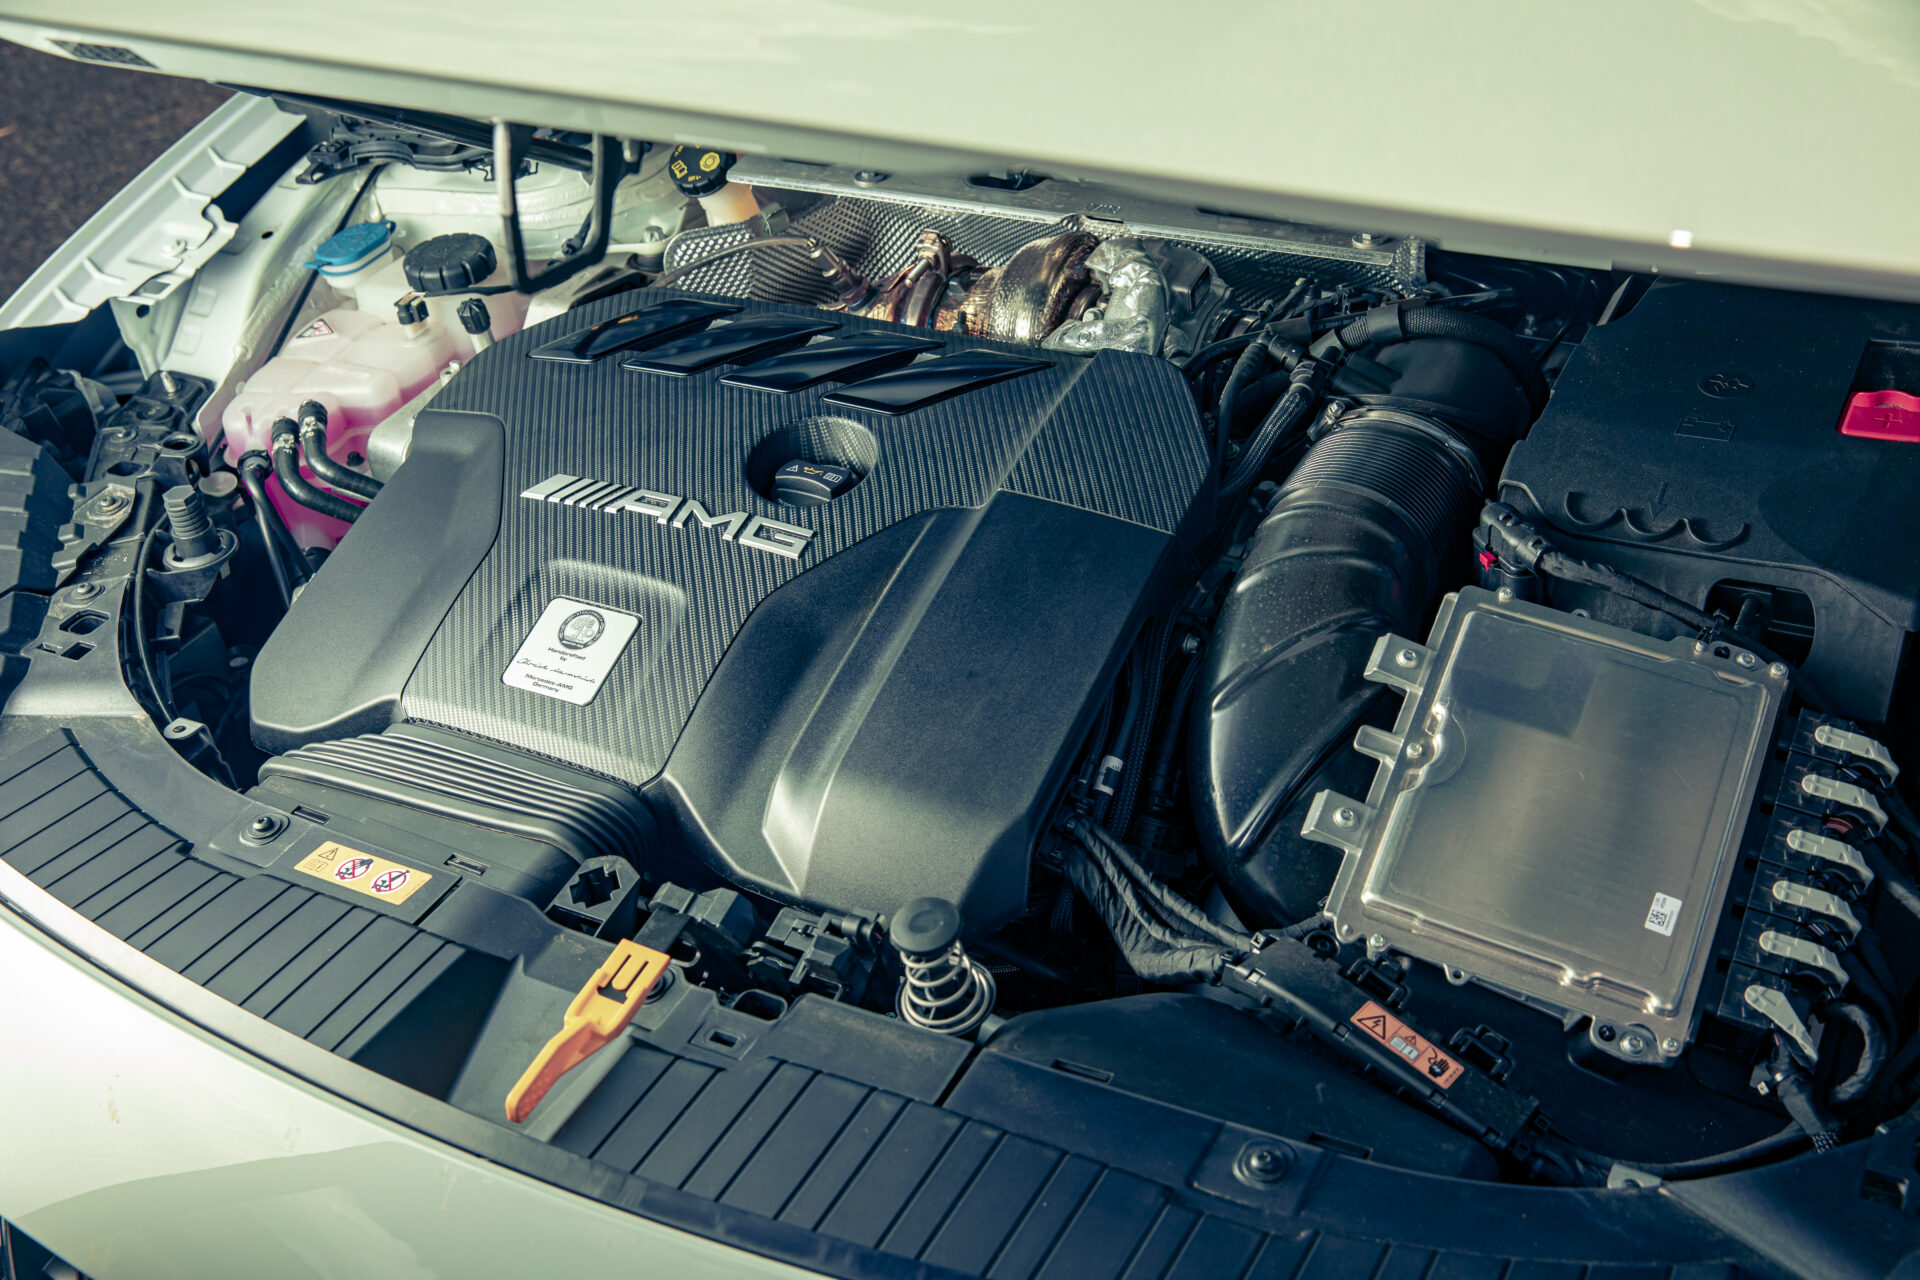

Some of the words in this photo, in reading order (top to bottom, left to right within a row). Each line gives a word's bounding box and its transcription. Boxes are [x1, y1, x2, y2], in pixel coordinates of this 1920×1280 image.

[604, 488, 815, 559] AMG
[548, 647, 586, 660] Handcrafted
[525, 673, 574, 690] Mercedes-AMG
[532, 681, 560, 693] Germany
